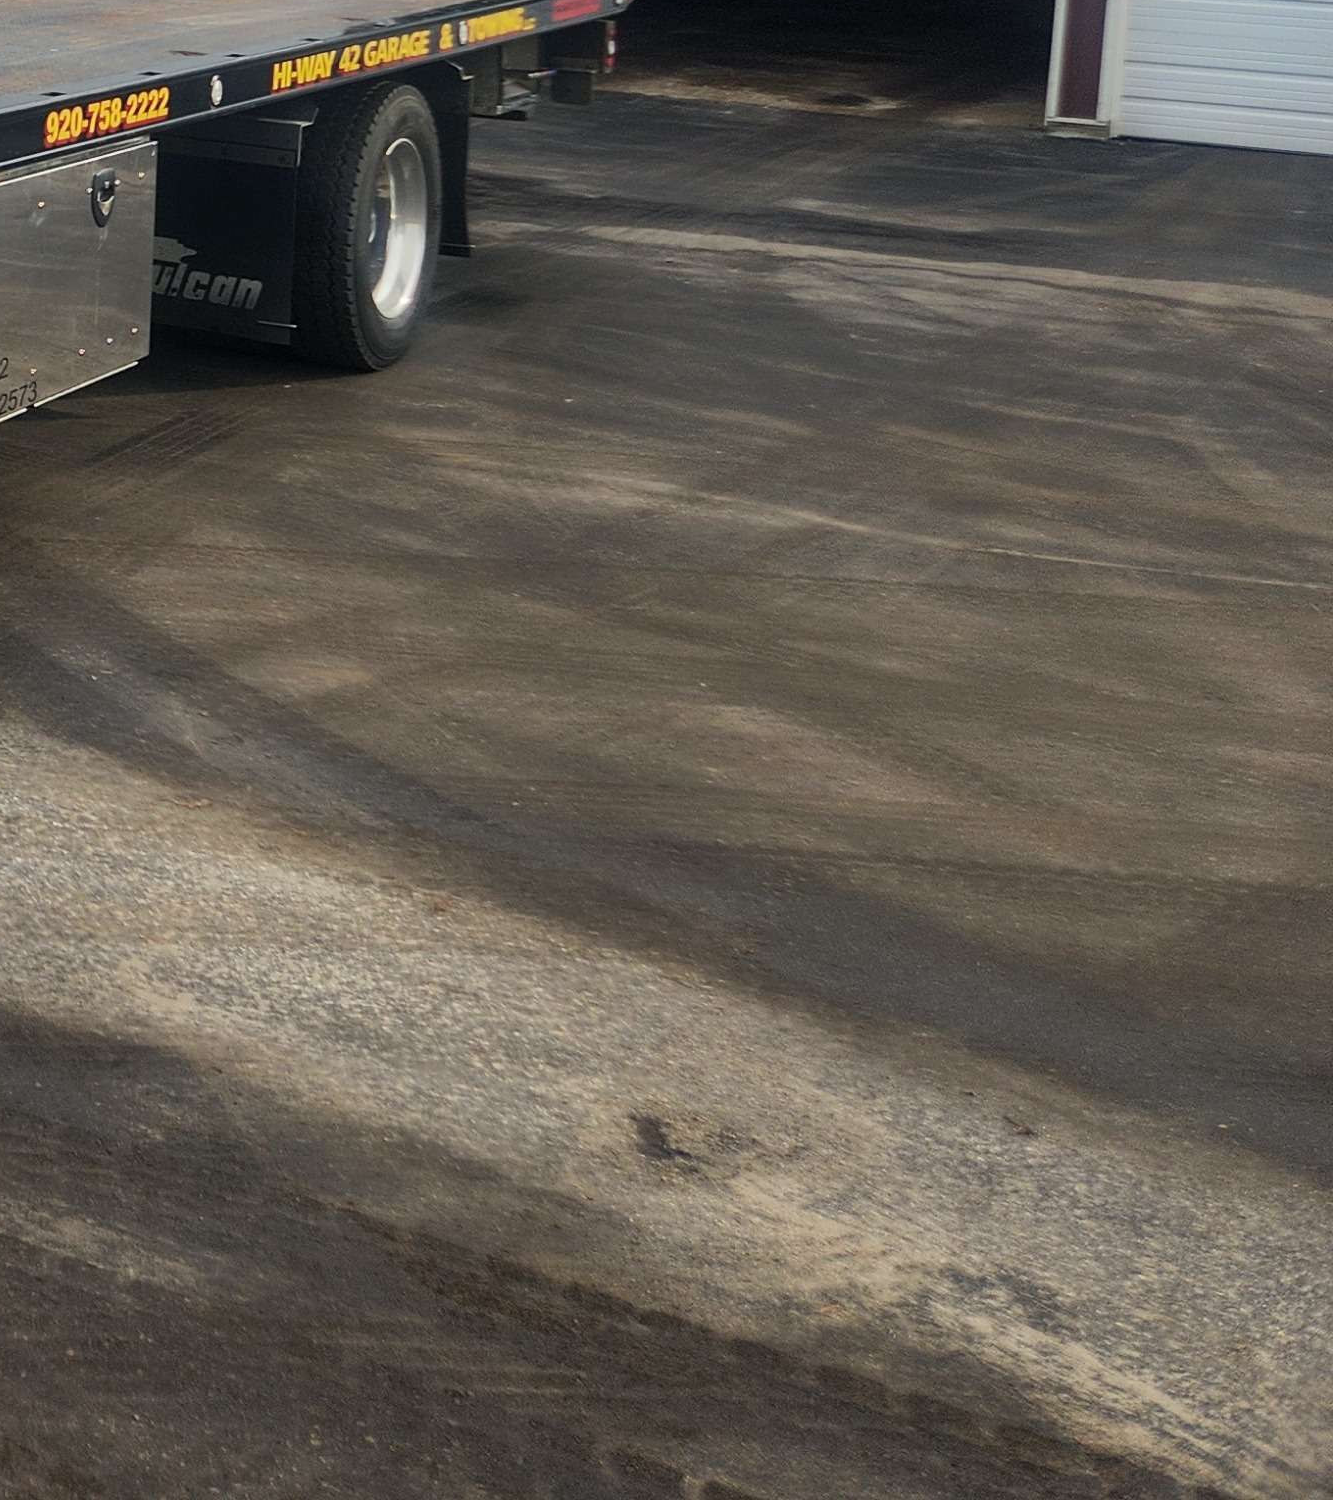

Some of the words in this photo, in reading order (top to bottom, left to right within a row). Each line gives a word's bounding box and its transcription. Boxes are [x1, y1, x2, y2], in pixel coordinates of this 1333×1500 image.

[271, 50, 337, 92] HI-WAY
[338, 45, 360, 72] 42
[363, 30, 431, 67] GARAGE
[439, 23, 453, 50] &
[45, 87, 170, 147] 920-758-2222
[152, 263, 263, 309] ulcan
